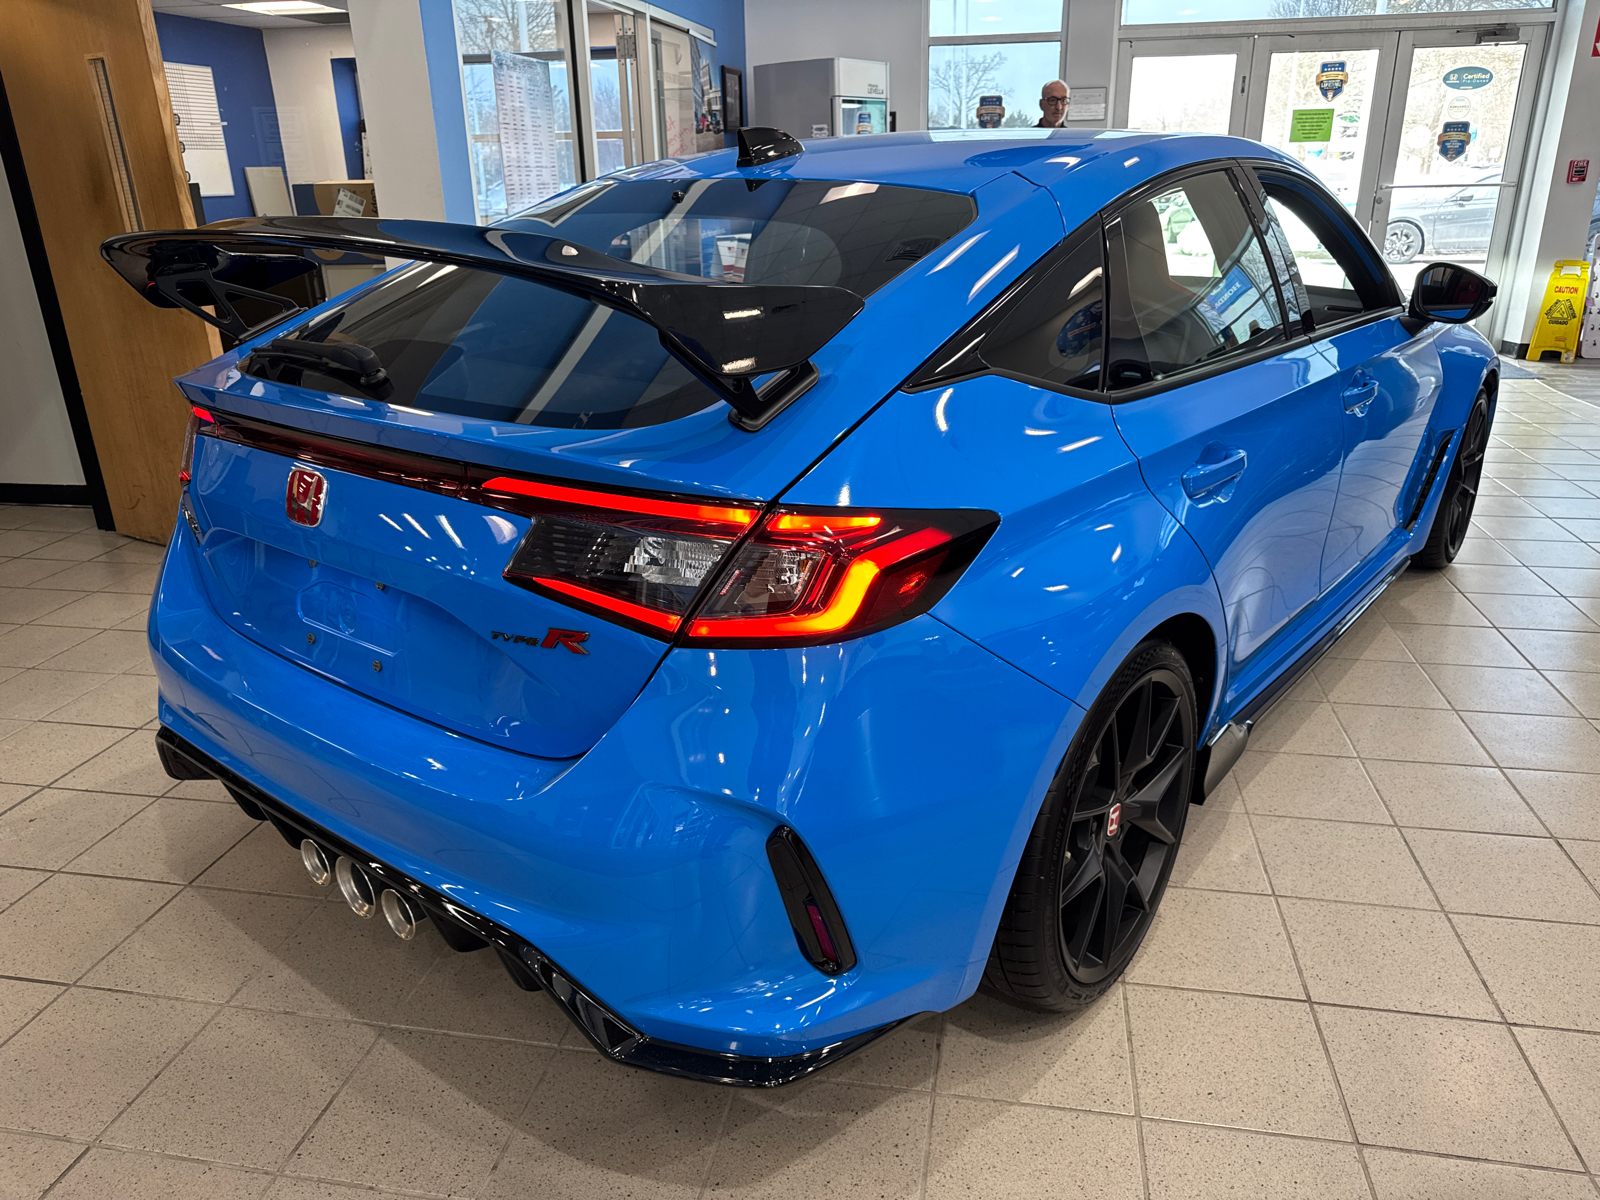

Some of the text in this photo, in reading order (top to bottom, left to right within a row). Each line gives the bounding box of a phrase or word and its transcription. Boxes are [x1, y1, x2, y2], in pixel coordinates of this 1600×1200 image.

[1554, 286, 1579, 294] CAUTION
[491, 627, 591, 655] TYPE R
[1048, 866, 1056, 895] PILOT
[1052, 825, 1064, 861] SPORT
